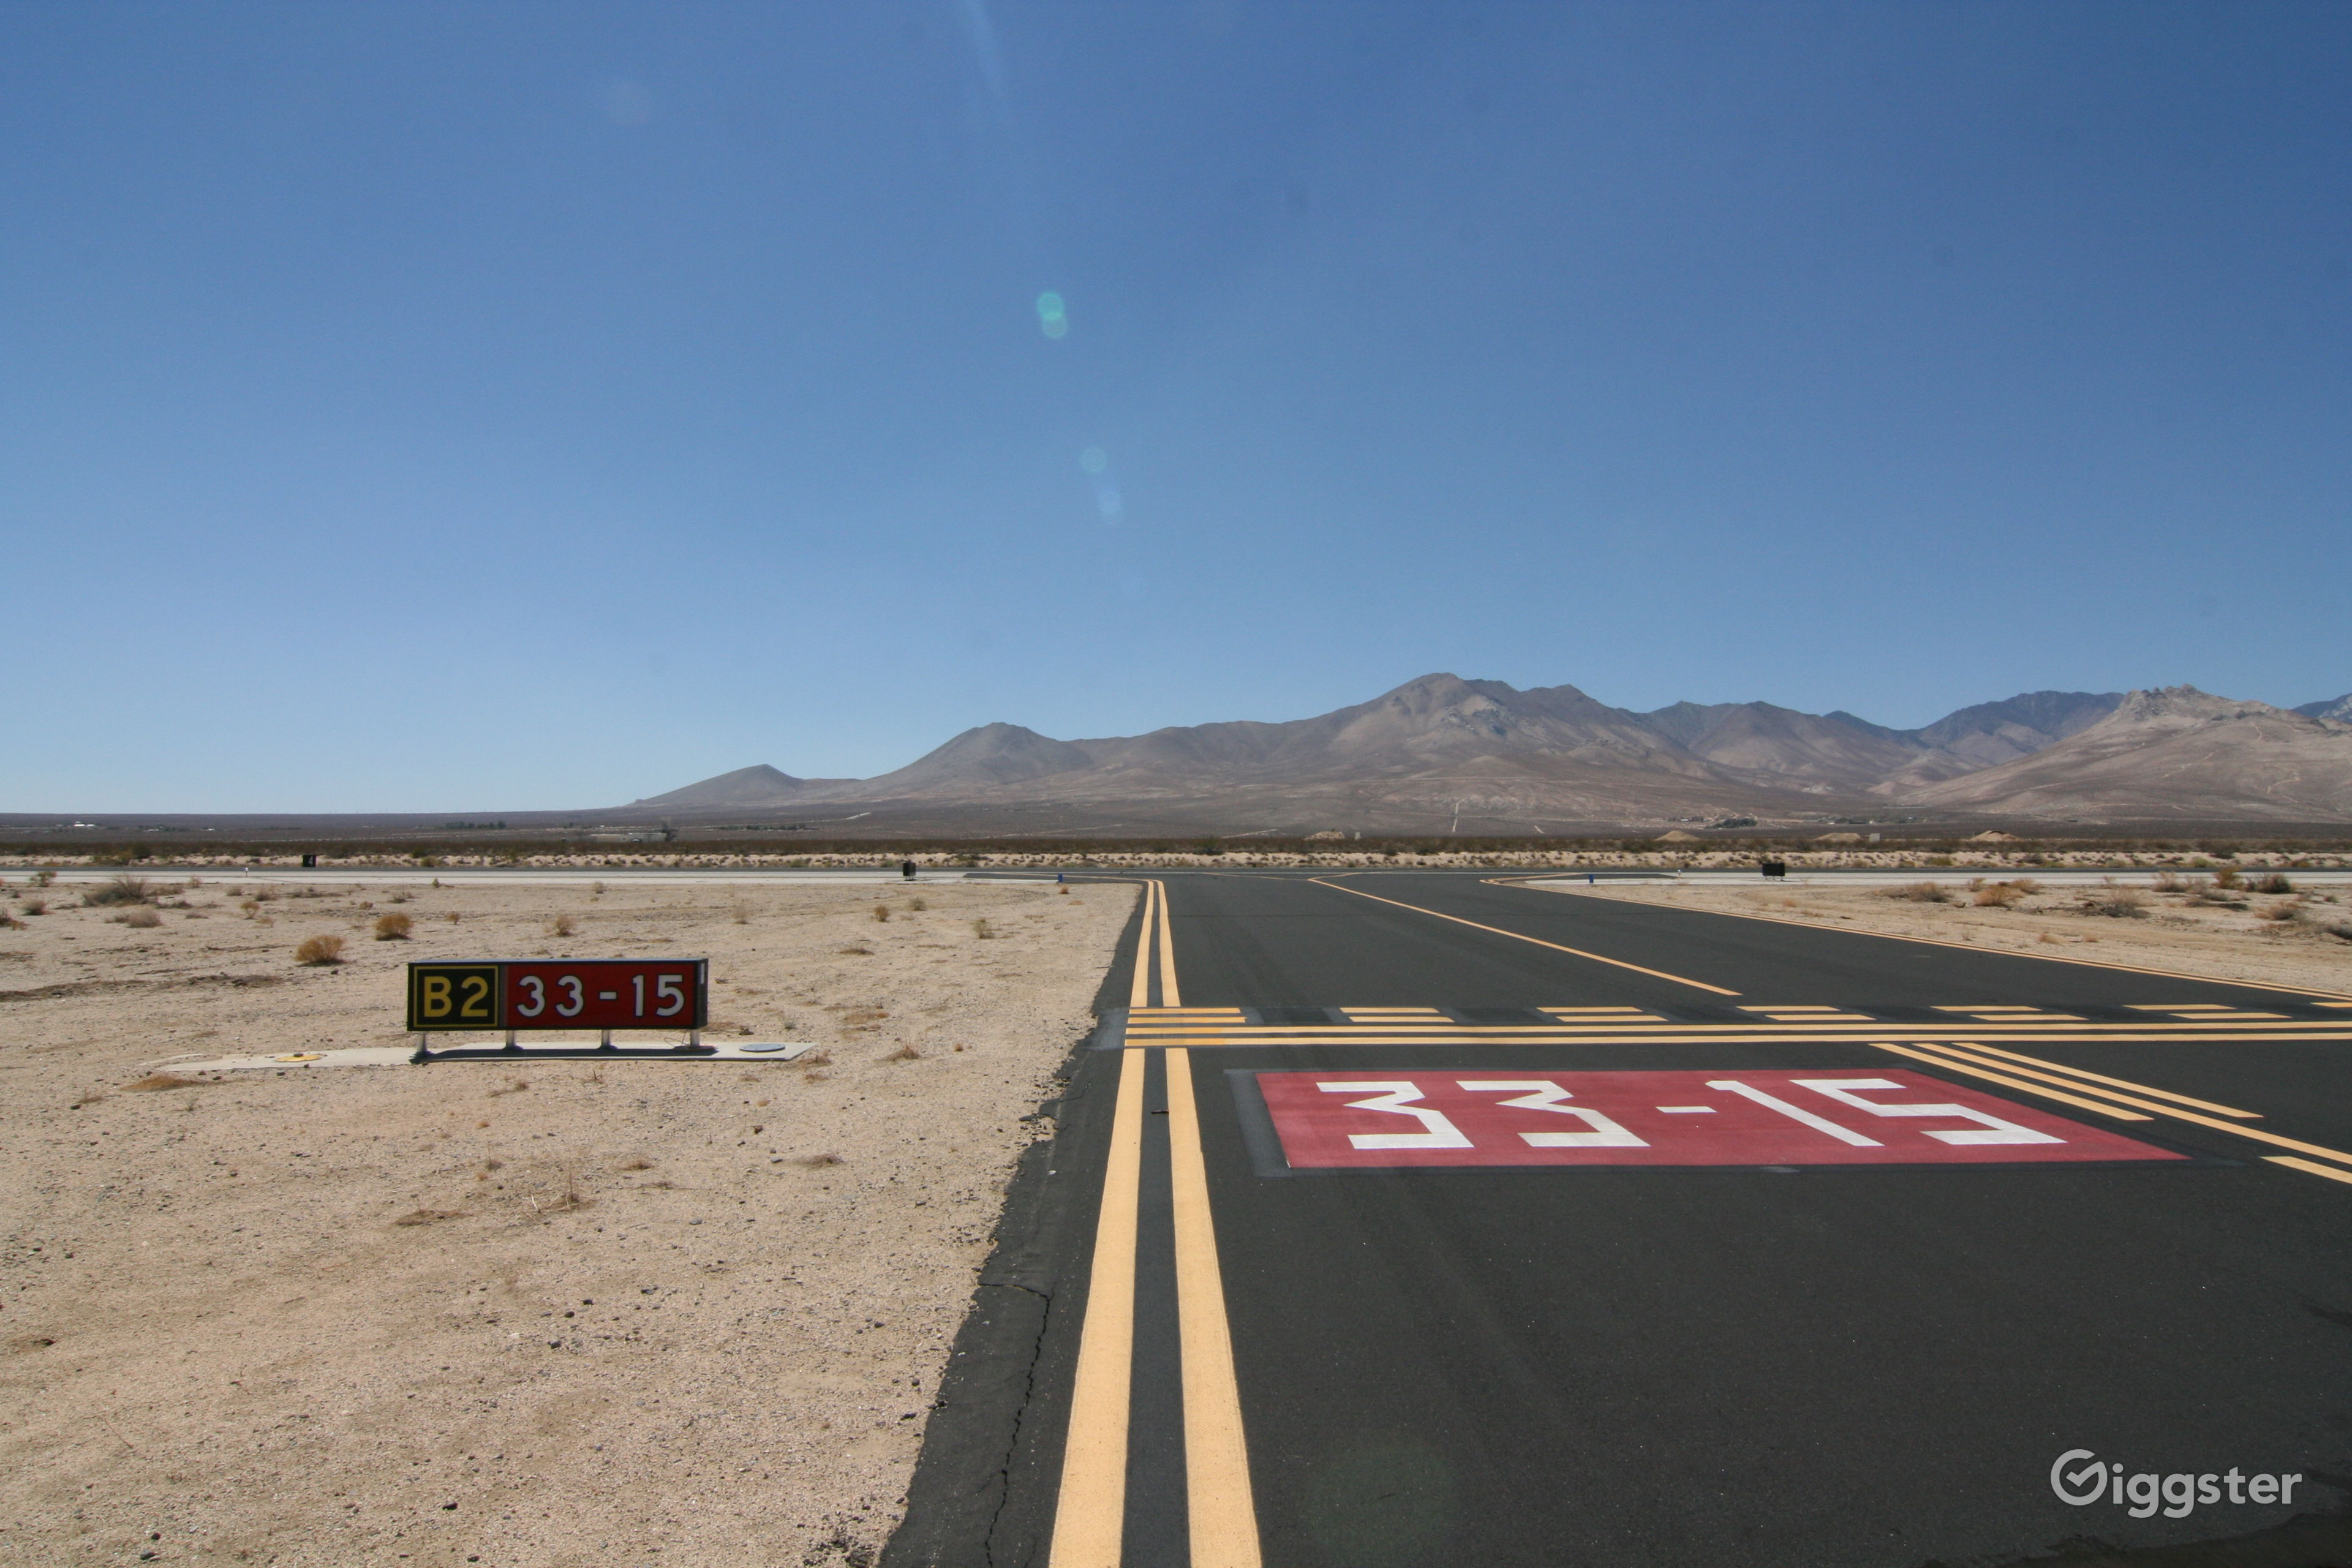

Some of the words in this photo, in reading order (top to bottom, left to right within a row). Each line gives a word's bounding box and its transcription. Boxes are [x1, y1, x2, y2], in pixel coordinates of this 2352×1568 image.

[424, 976, 488, 1017] B2
[517, 974, 685, 1017] 33-15
[1316, 1079, 2068, 1148] 33-15
